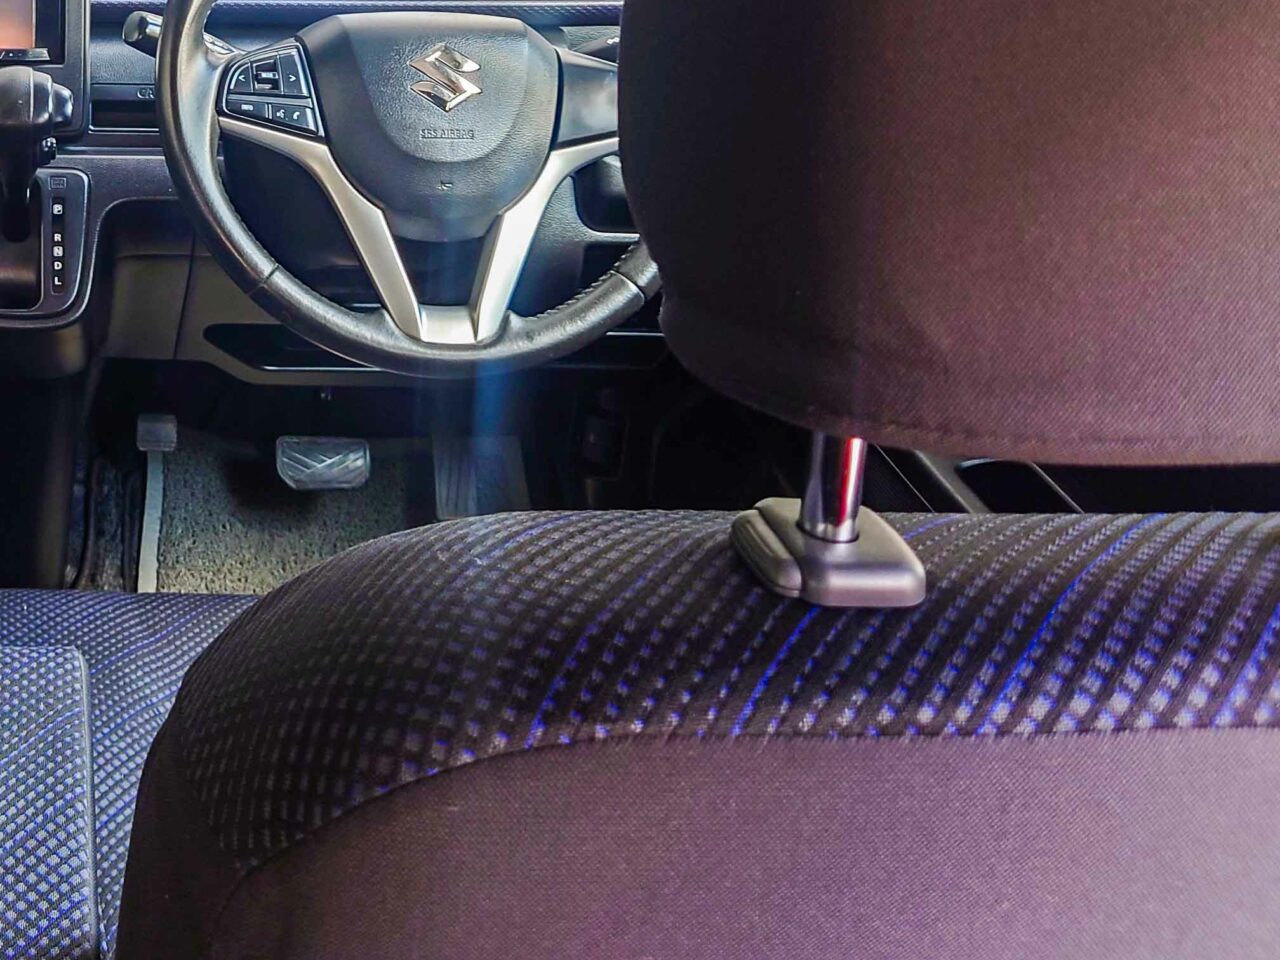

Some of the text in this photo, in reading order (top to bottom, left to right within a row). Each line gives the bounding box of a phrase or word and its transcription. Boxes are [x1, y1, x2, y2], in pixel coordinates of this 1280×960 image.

[420, 128, 475, 139] SRS AIRBAG
[54, 233, 62, 242] R
[54, 261, 62, 270] D
[54, 276, 62, 285] L
